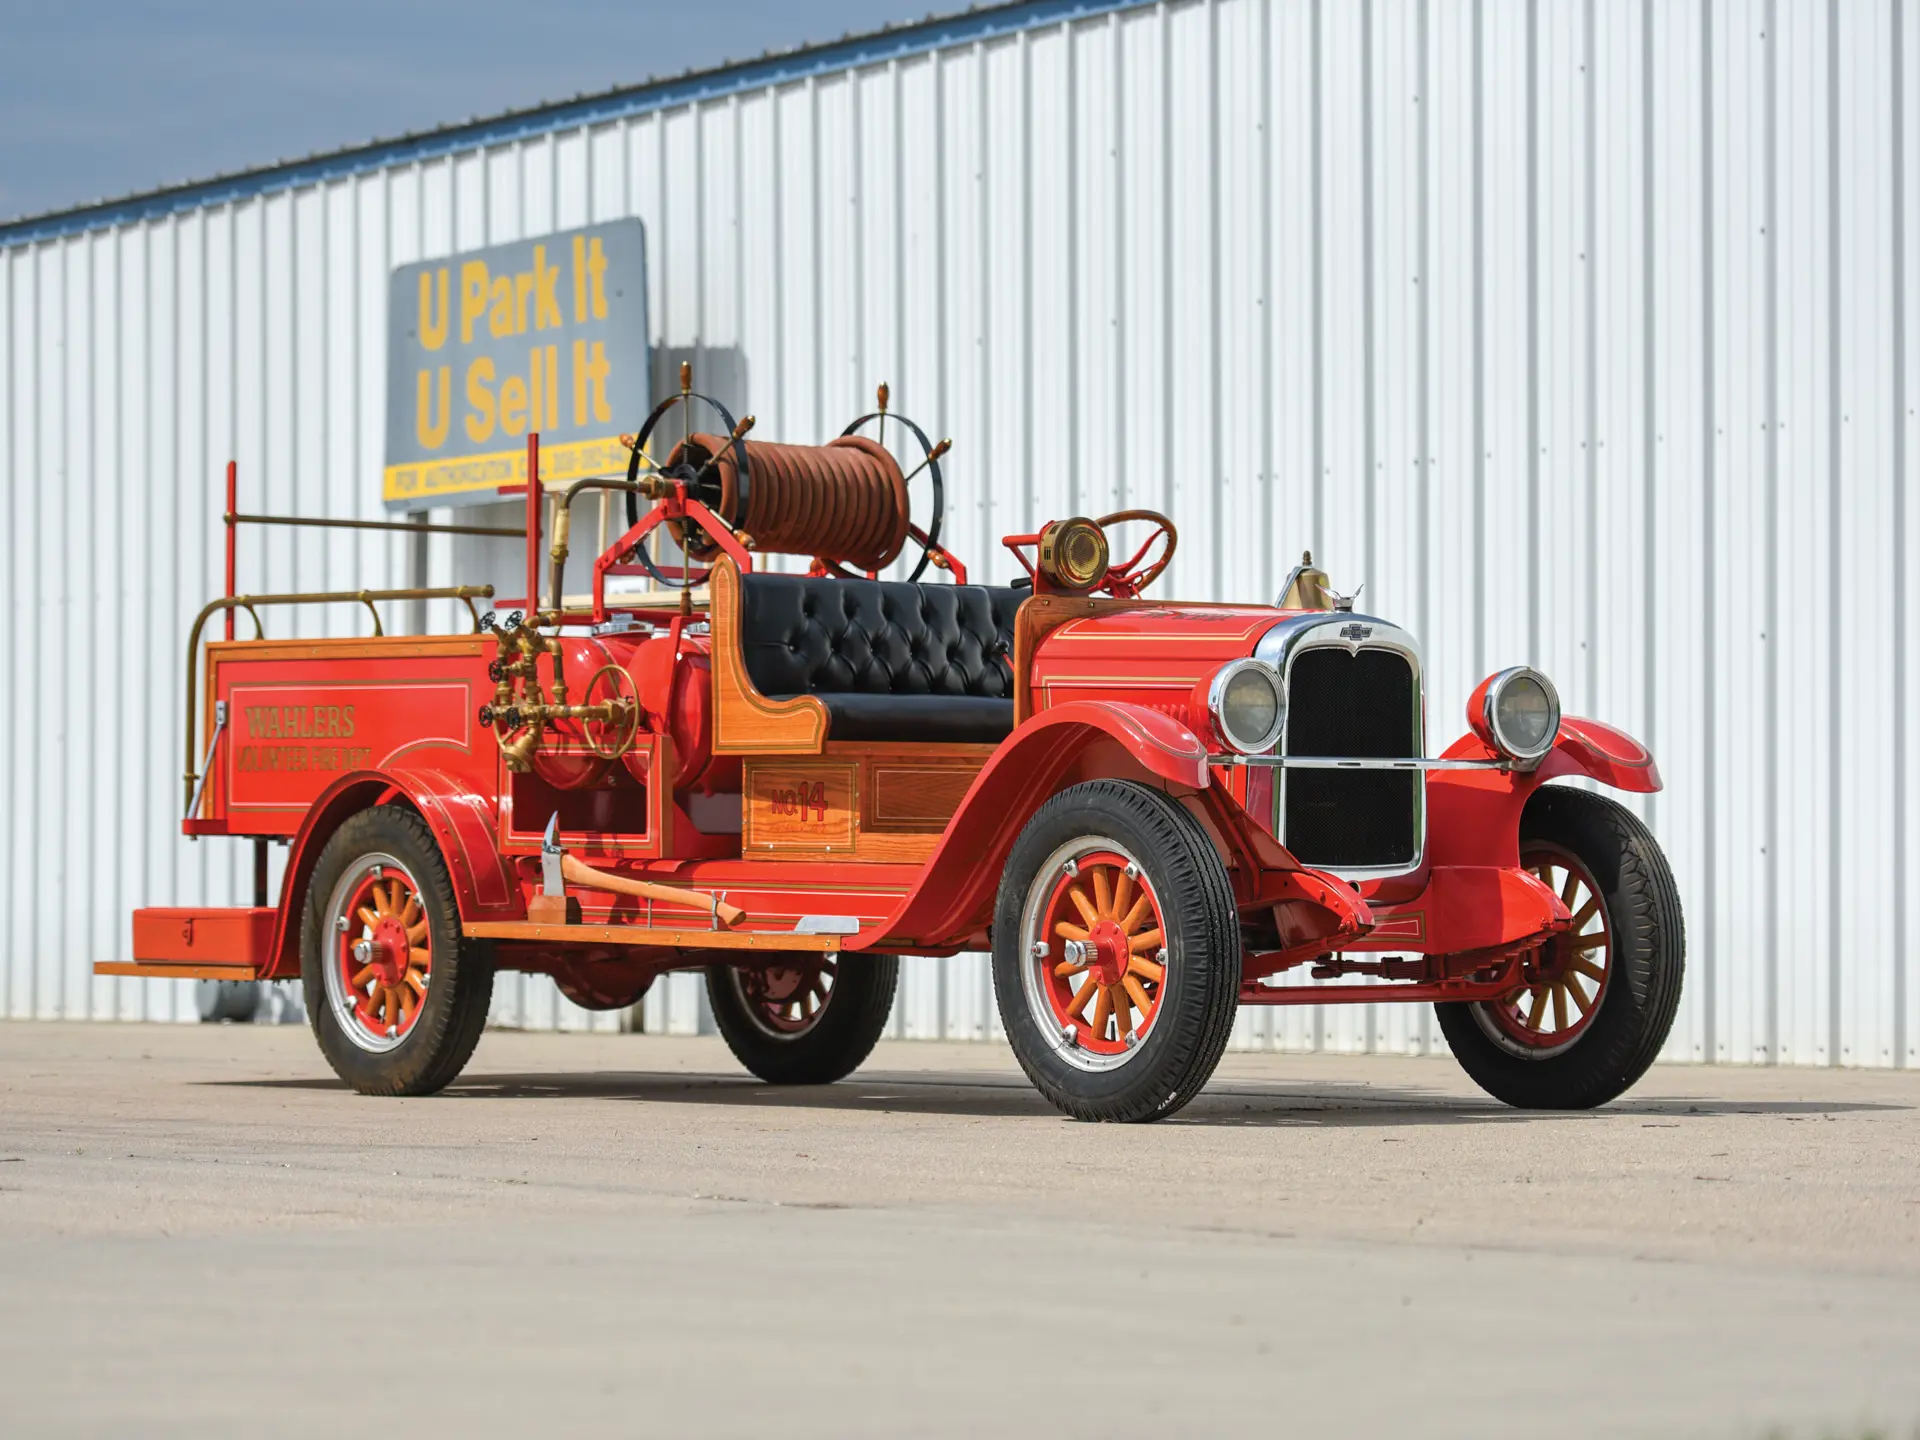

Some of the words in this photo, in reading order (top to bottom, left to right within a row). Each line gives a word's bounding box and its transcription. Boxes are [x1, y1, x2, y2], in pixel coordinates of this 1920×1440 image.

[418, 267, 450, 351] U
[460, 245, 563, 344] Park
[572, 234, 608, 323] It
[416, 366, 451, 449] U
[464, 345, 559, 443] Sell
[572, 340, 612, 426] It
[245, 706, 356, 738] WAHLERS
